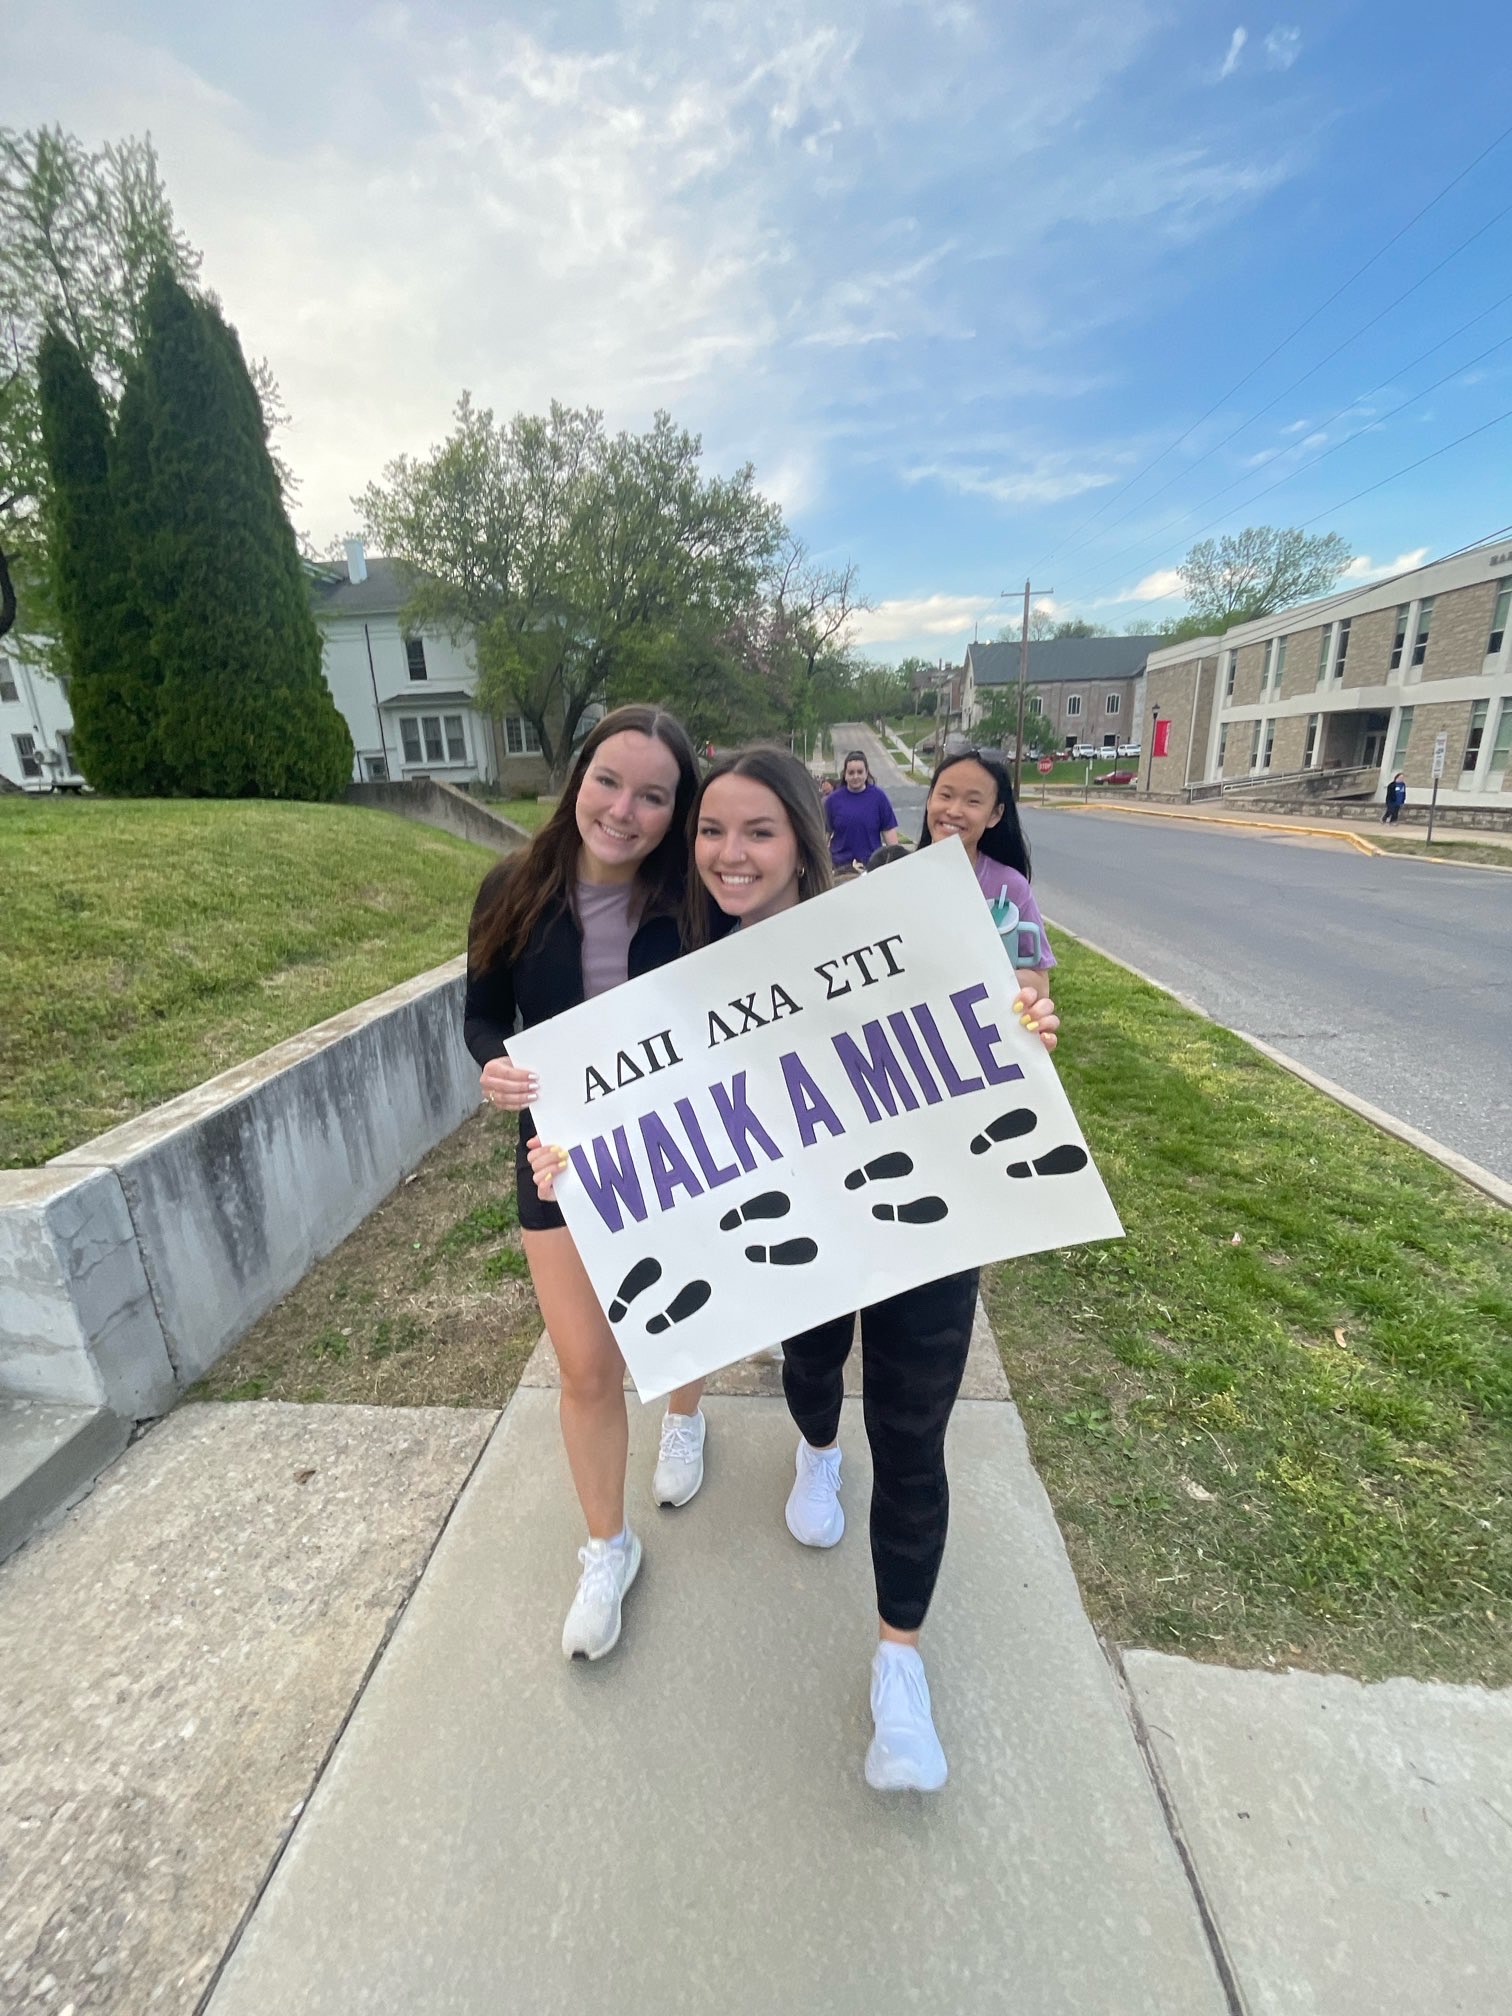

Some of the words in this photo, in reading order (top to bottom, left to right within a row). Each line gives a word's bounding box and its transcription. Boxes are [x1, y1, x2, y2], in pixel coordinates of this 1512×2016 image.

[1039, 762, 1052, 771] STOP
[584, 1030, 683, 1104] ΑΔΠ
[569, 1070, 783, 1234] WALK
[779, 1051, 846, 1148] A
[831, 983, 1025, 1123] MILE
